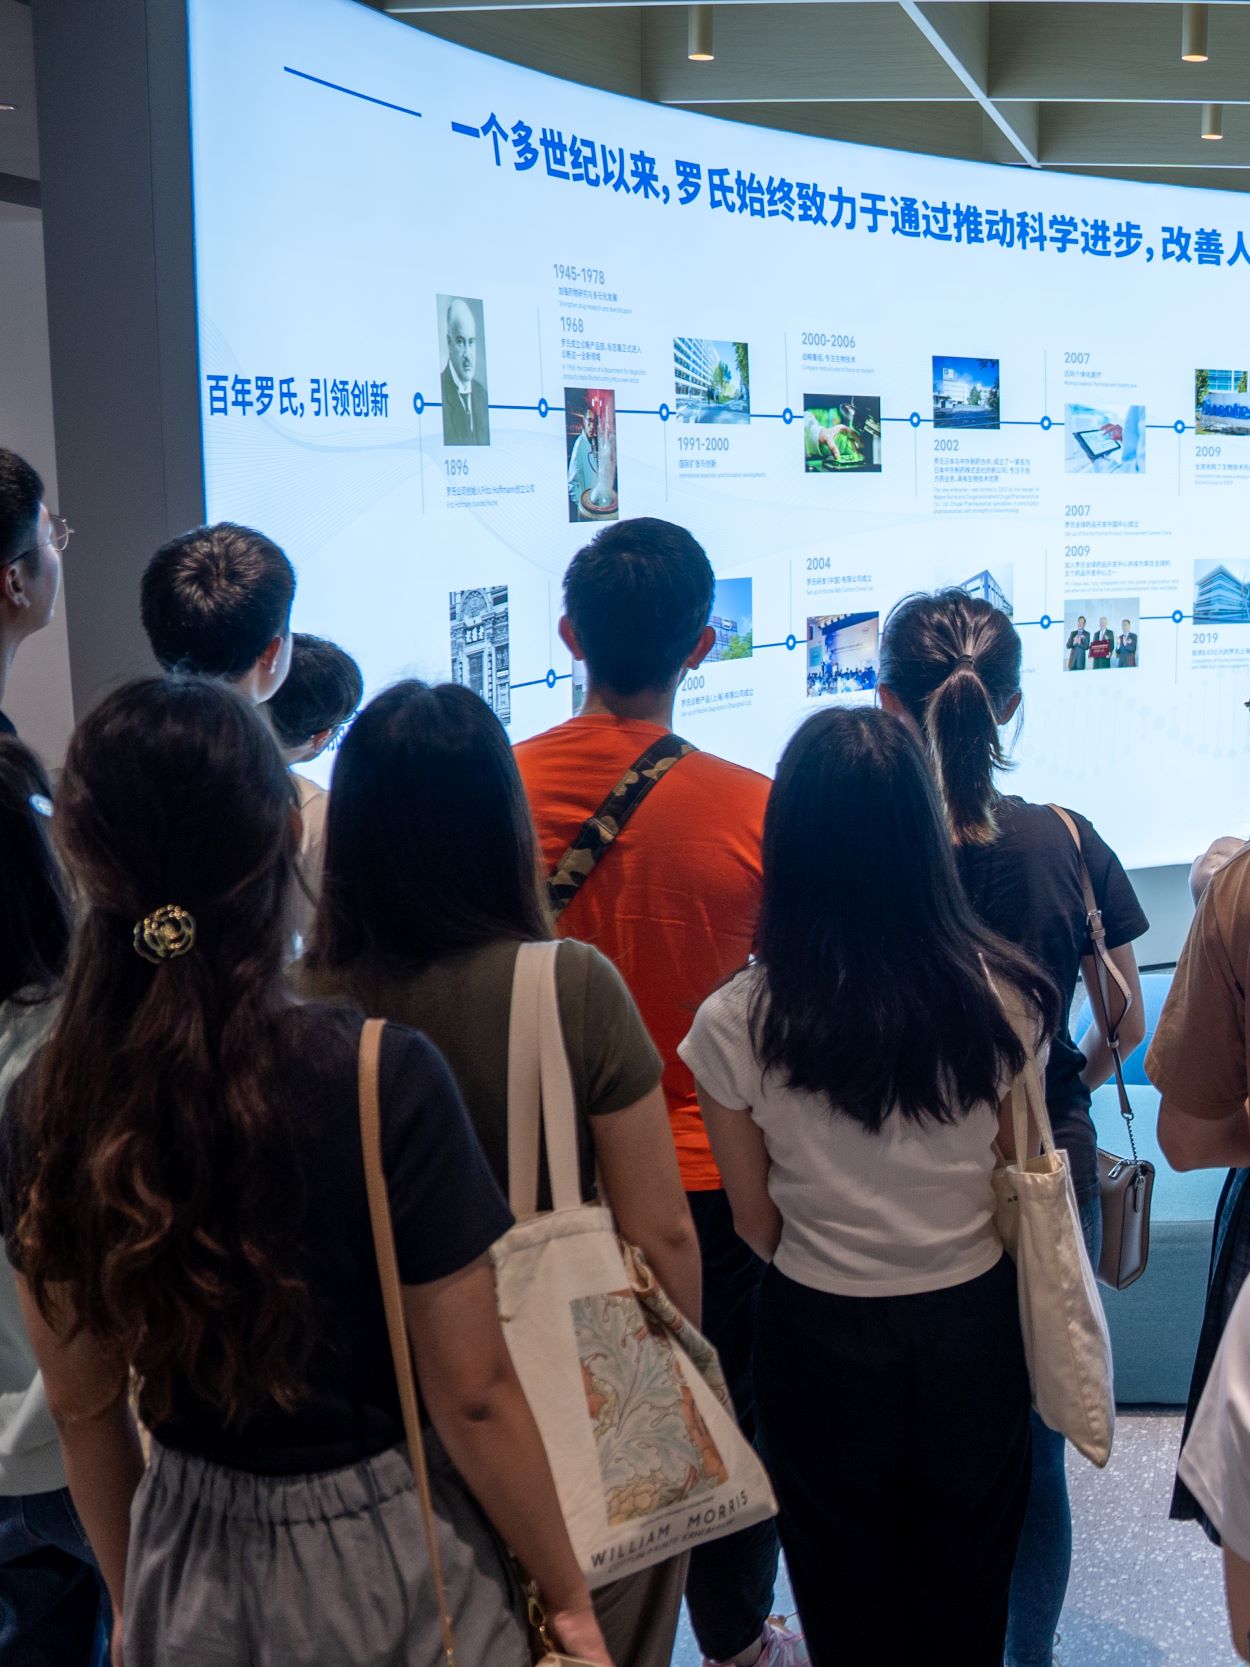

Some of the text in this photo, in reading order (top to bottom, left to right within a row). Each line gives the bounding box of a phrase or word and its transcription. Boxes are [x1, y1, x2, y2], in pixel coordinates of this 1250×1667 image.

[554, 264, 605, 285] 1945-1978
[560, 316, 585, 334] 1968
[801, 332, 856, 348] 2000-2006
[1064, 351, 1090, 364] 2007
[206, 374, 389, 418] 百年罗氏，引领创新
[678, 437, 729, 451] 1991-2000
[934, 439, 959, 451] 2002
[1195, 446, 1222, 457] 2009
[444, 459, 468, 476] 1896
[1065, 505, 1091, 517] 2007
[1065, 545, 1091, 557] 2009
[806, 557, 831, 571] 2004
[1192, 632, 1219, 644] 2019
[592, 1524, 671, 1568] WILLIAM
[687, 1490, 749, 1530] MORRIS
